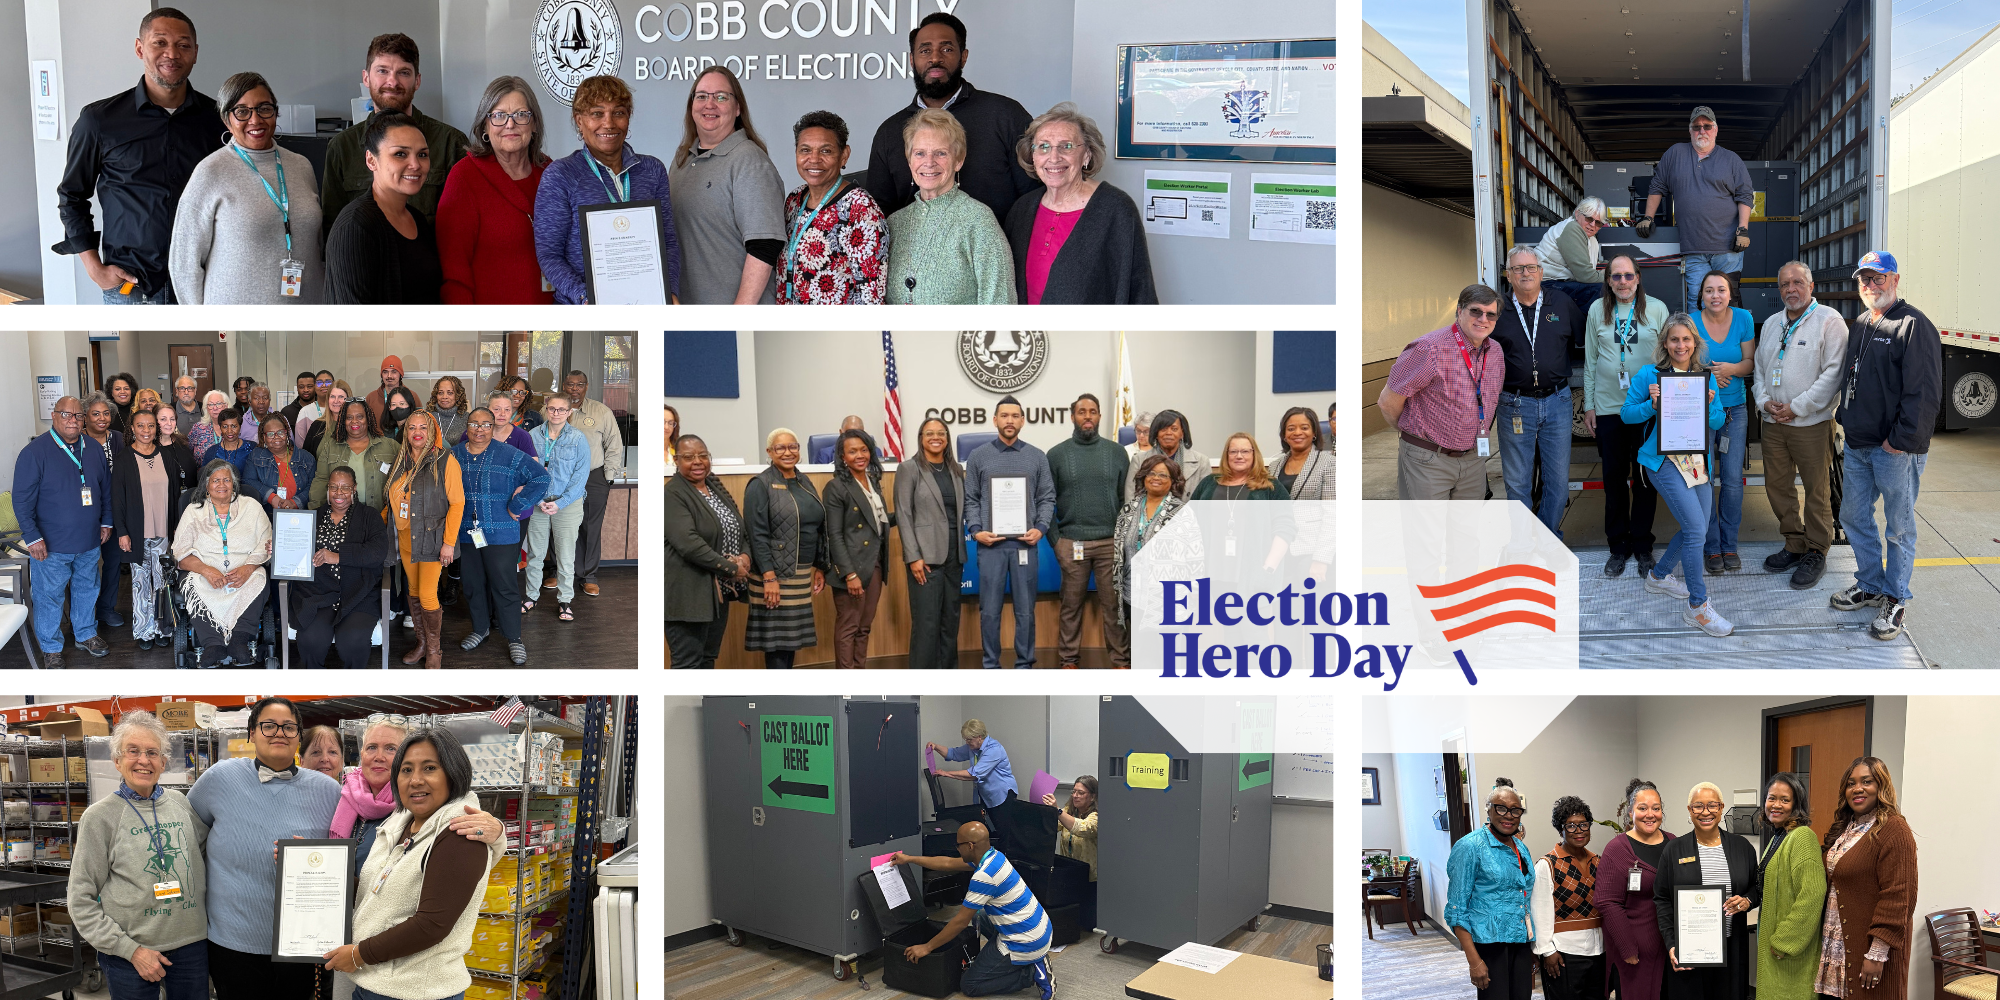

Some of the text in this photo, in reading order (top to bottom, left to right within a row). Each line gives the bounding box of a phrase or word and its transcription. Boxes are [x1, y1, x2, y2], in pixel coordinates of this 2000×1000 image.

[634, 1, 748, 43] COBB
[537, 51, 560, 91] STATE
[635, 53, 714, 81] BOARD
[727, 54, 758, 80] OF
[766, 51, 914, 81] ELECTION
[963, 340, 1044, 388] BOARD OF COMMISSIONERS
[994, 368, 1013, 376] 1832
[925, 407, 987, 424] COBB
[763, 720, 830, 746] CAST BALLOT
[783, 747, 809, 771] HERE
[1132, 765, 1164, 776] Training
[130, 821, 184, 836] Grasshopper
[144, 907, 172, 916] Flying
